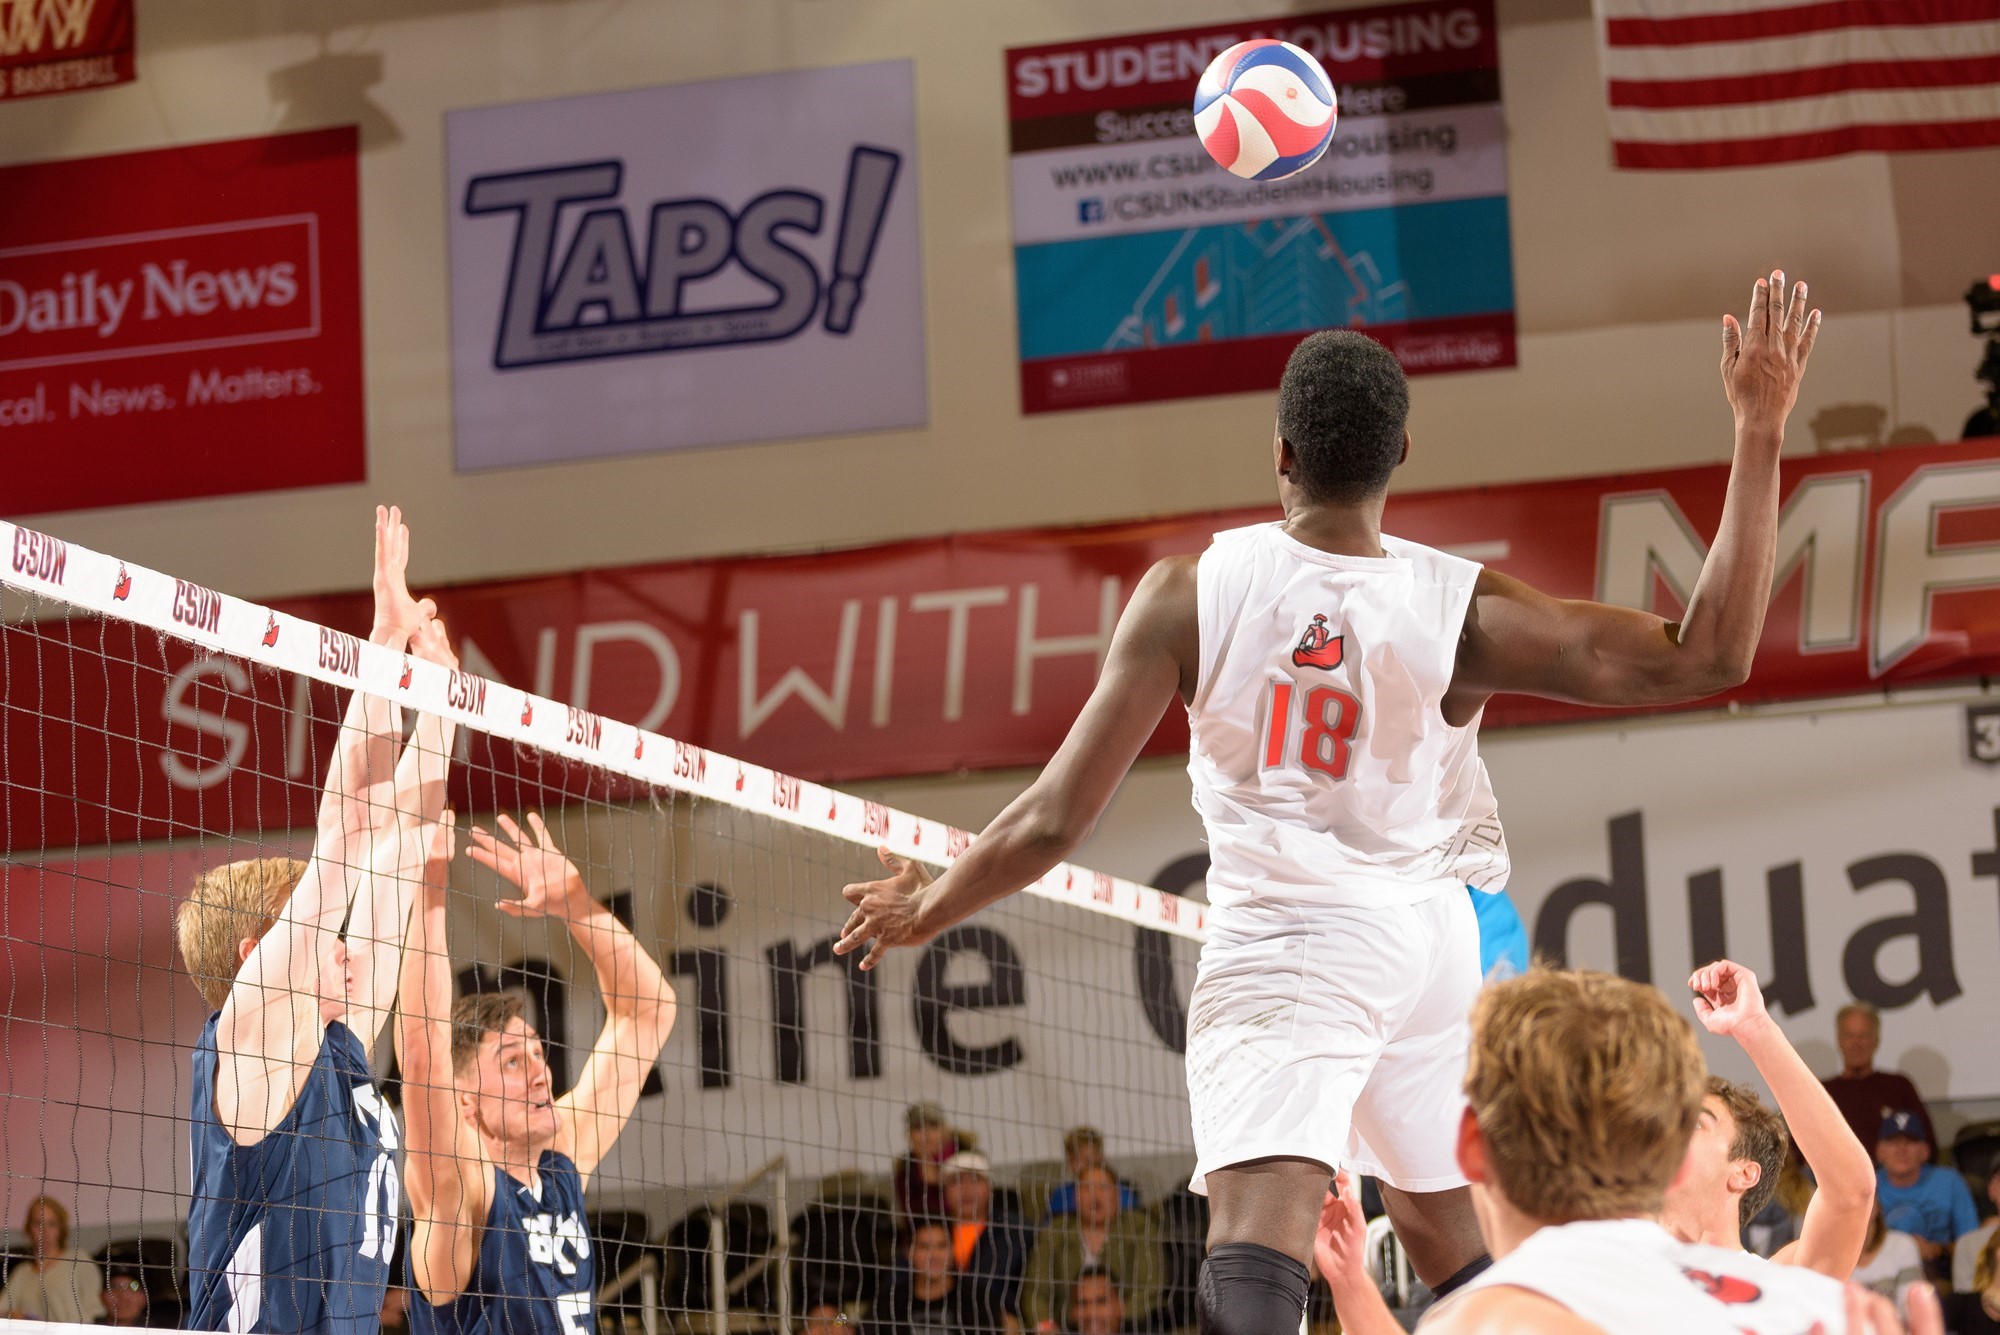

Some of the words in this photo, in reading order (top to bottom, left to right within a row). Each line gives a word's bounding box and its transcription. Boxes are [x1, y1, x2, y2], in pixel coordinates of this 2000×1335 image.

[1250, 9, 1481, 62] OUSING
[1094, 108, 1196, 144] Succe
[0, 268, 133, 338] Daily
[140, 258, 299, 320] News
[462, 141, 904, 372] TAPS!
[69, 378, 176, 419] News.
[186, 366, 323, 406] Matters.
[11, 526, 68, 586] CSUN
[172, 578, 223, 635] CSUN
[318, 626, 362, 679] CSUN
[447, 669, 488, 717] CSUN
[565, 705, 602, 751] CSUN
[672, 739, 707, 784] CSUN
[739, 575, 1121, 741] WITH
[1261, 678, 1364, 783] 18
